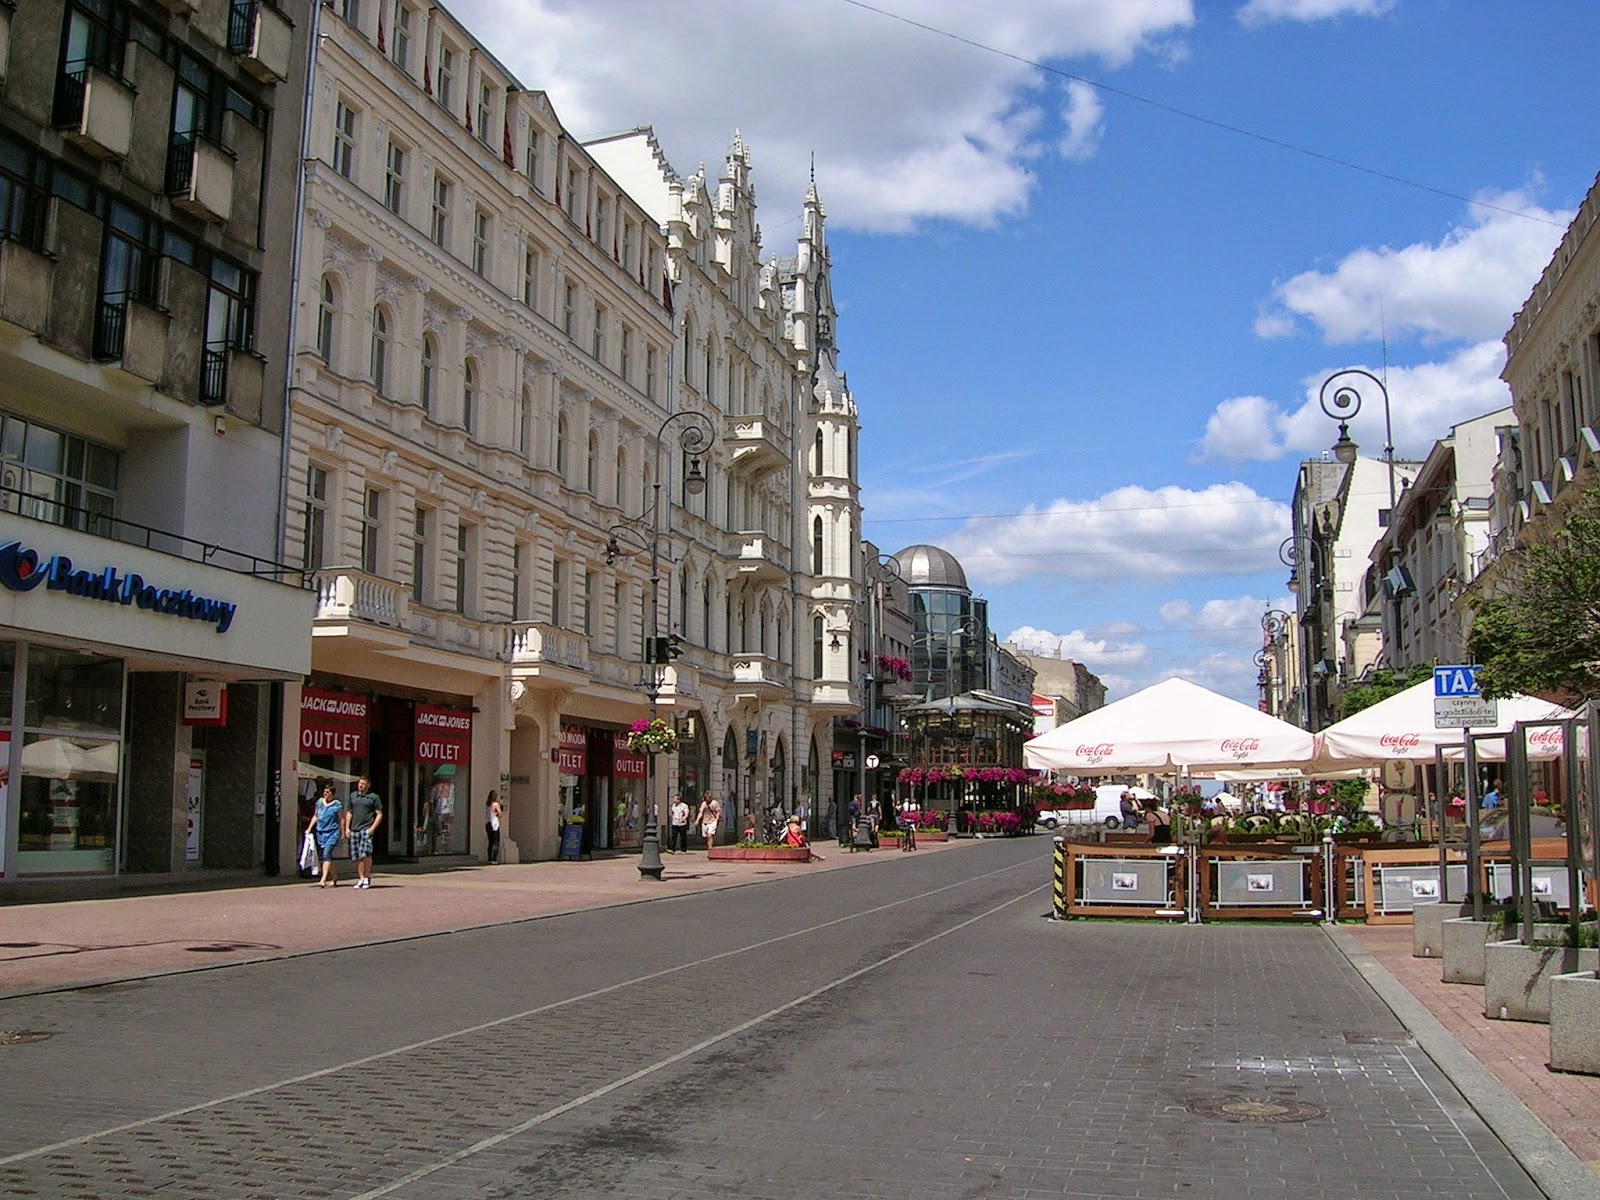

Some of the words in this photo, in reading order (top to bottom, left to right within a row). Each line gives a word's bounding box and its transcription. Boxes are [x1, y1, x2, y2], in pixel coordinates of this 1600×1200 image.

[46, 556, 123, 603] Bank
[120, 573, 237, 633] Pocztowy
[1436, 669, 1480, 694] TAX
[301, 696, 328, 711] JACK
[335, 701, 367, 717] JONES
[417, 713, 440, 726] JACK
[446, 716, 470, 730] JONES
[302, 729, 360, 752] OUTLET
[567, 732, 587, 745] MODA
[419, 741, 460, 760] OUTLET
[616, 759, 645, 773] OUTLET
